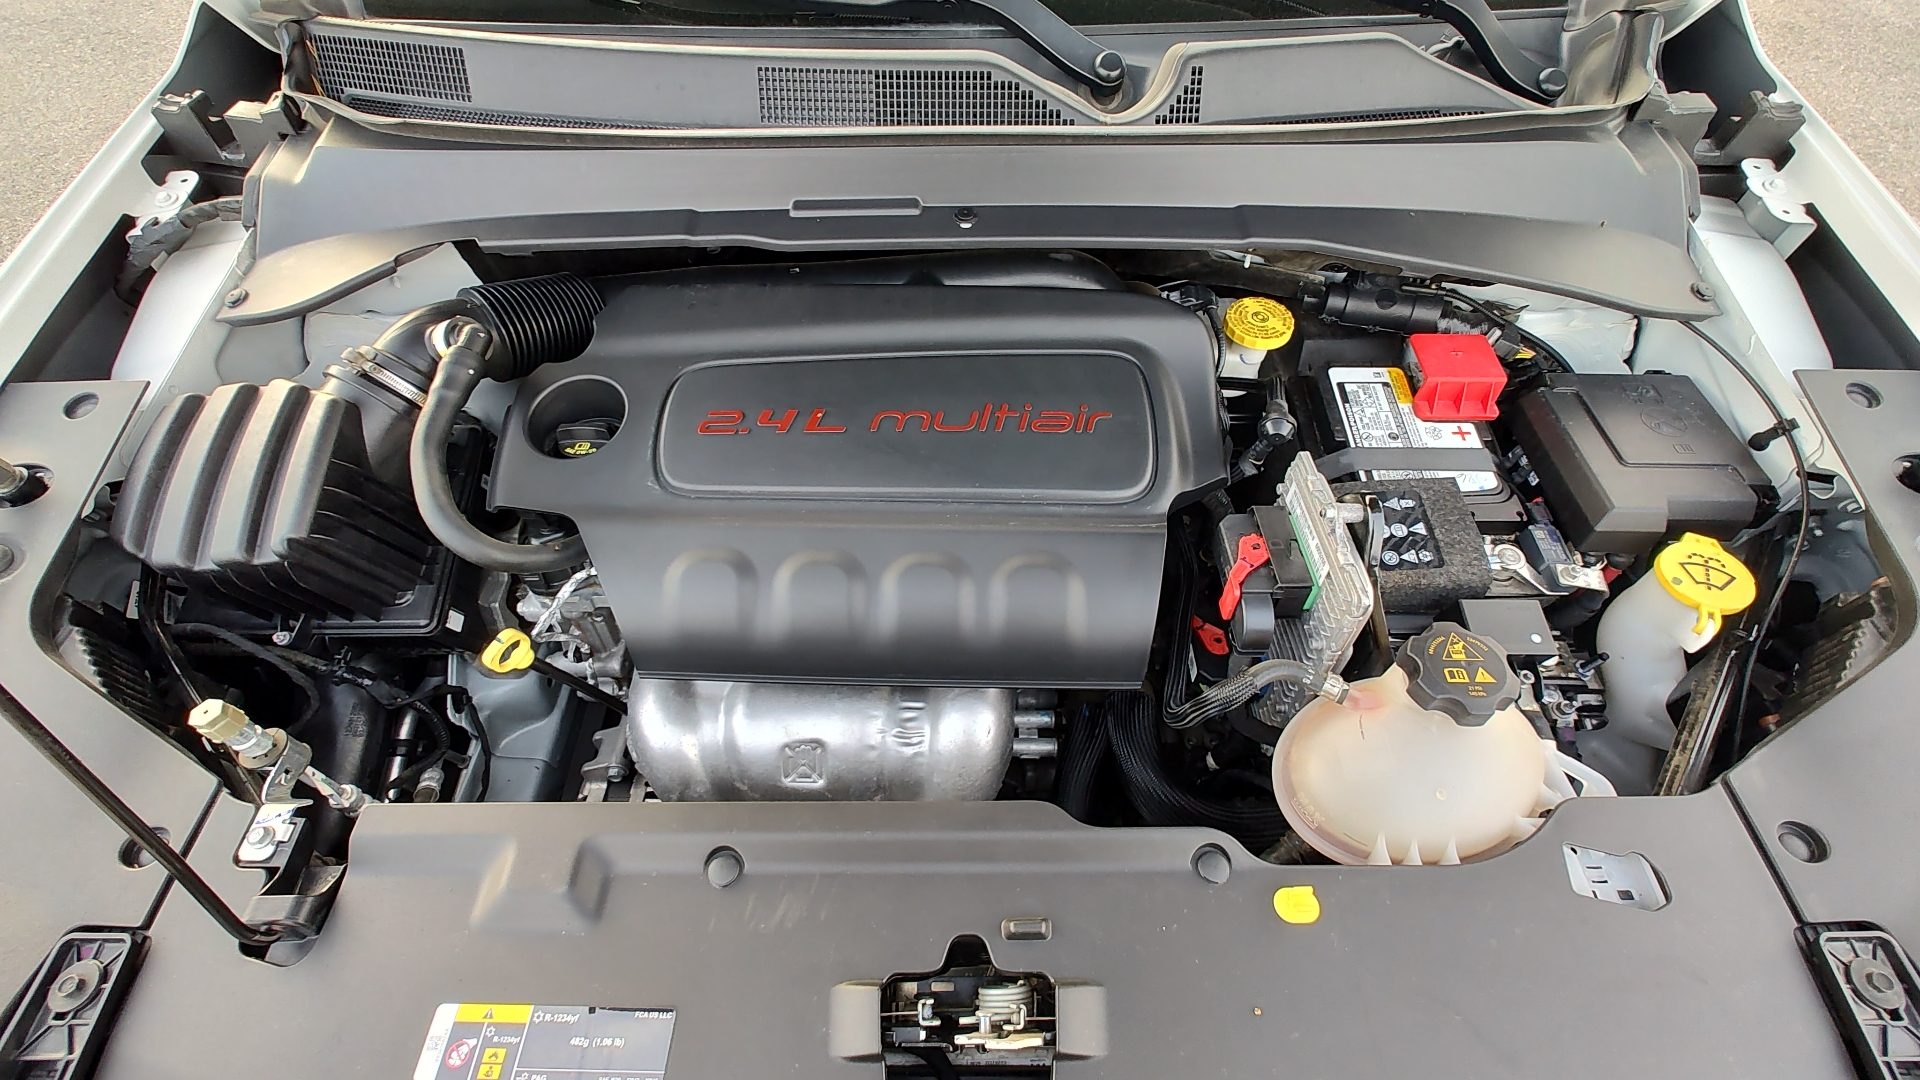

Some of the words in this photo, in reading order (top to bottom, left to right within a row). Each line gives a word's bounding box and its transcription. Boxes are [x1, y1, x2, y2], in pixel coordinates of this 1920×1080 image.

[870, 402, 1113, 434] multiair
[1344, 403, 1364, 448] ANGER/POISON
[543, 1013, 580, 1025] R-1234yf
[634, 1011, 649, 1019] FCA
[649, 1011, 659, 1019] US
[659, 1011, 673, 1020] LLC
[492, 1035, 521, 1045] R-1234yf
[569, 1036, 590, 1048] 482g
[612, 1037, 625, 1049] lb)
